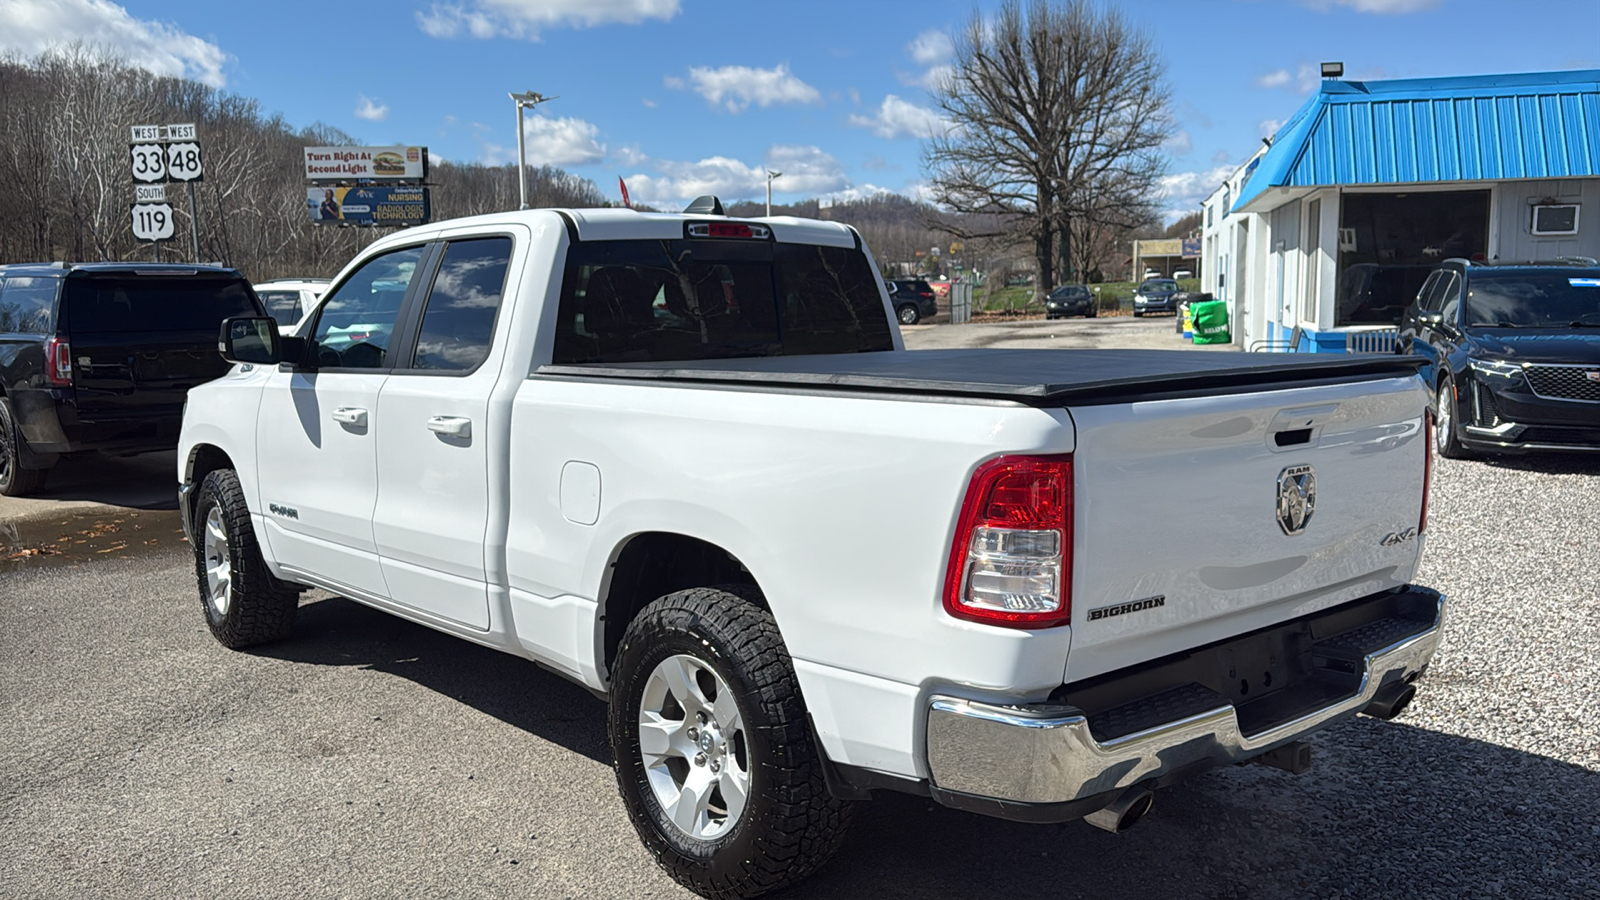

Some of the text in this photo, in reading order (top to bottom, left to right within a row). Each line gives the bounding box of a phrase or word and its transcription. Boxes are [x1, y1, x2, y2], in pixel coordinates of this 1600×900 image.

[133, 127, 158, 139] WEST
[169, 126, 194, 138] WEST
[136, 151, 162, 174] 33
[171, 150, 198, 172] 48
[307, 151, 371, 162] Turn Right At
[308, 164, 367, 174] Second Light
[137, 187, 164, 199] SOUTH
[388, 193, 423, 201] NURSING
[377, 204, 424, 212] RADIOLOGIC
[372, 211, 424, 219] TECHNOLOGY
[139, 210, 166, 233] 119
[1287, 466, 1311, 475] RAM
[1087, 594, 1166, 622] BIGHORN
